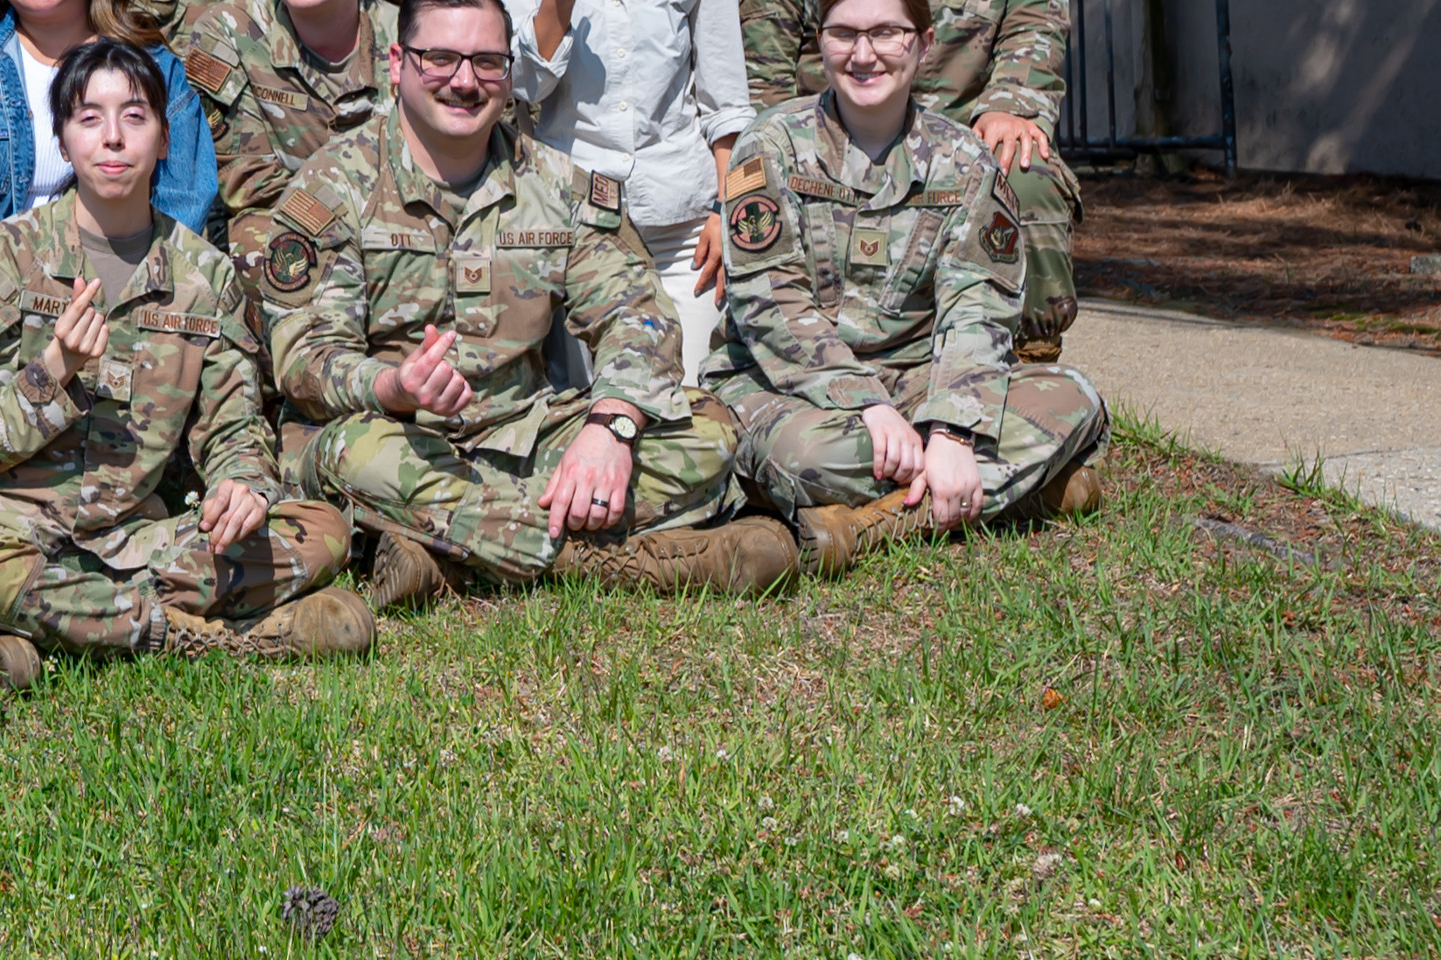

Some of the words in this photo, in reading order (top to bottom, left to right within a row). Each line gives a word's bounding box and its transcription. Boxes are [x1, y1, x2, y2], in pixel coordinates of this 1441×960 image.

[926, 190, 961, 205] FORCE
[519, 231, 535, 245] AIR
[538, 231, 573, 245] FORCE
[32, 296, 70, 315] MART
[162, 315, 182, 330] AIR
[184, 317, 219, 334] FORCE
